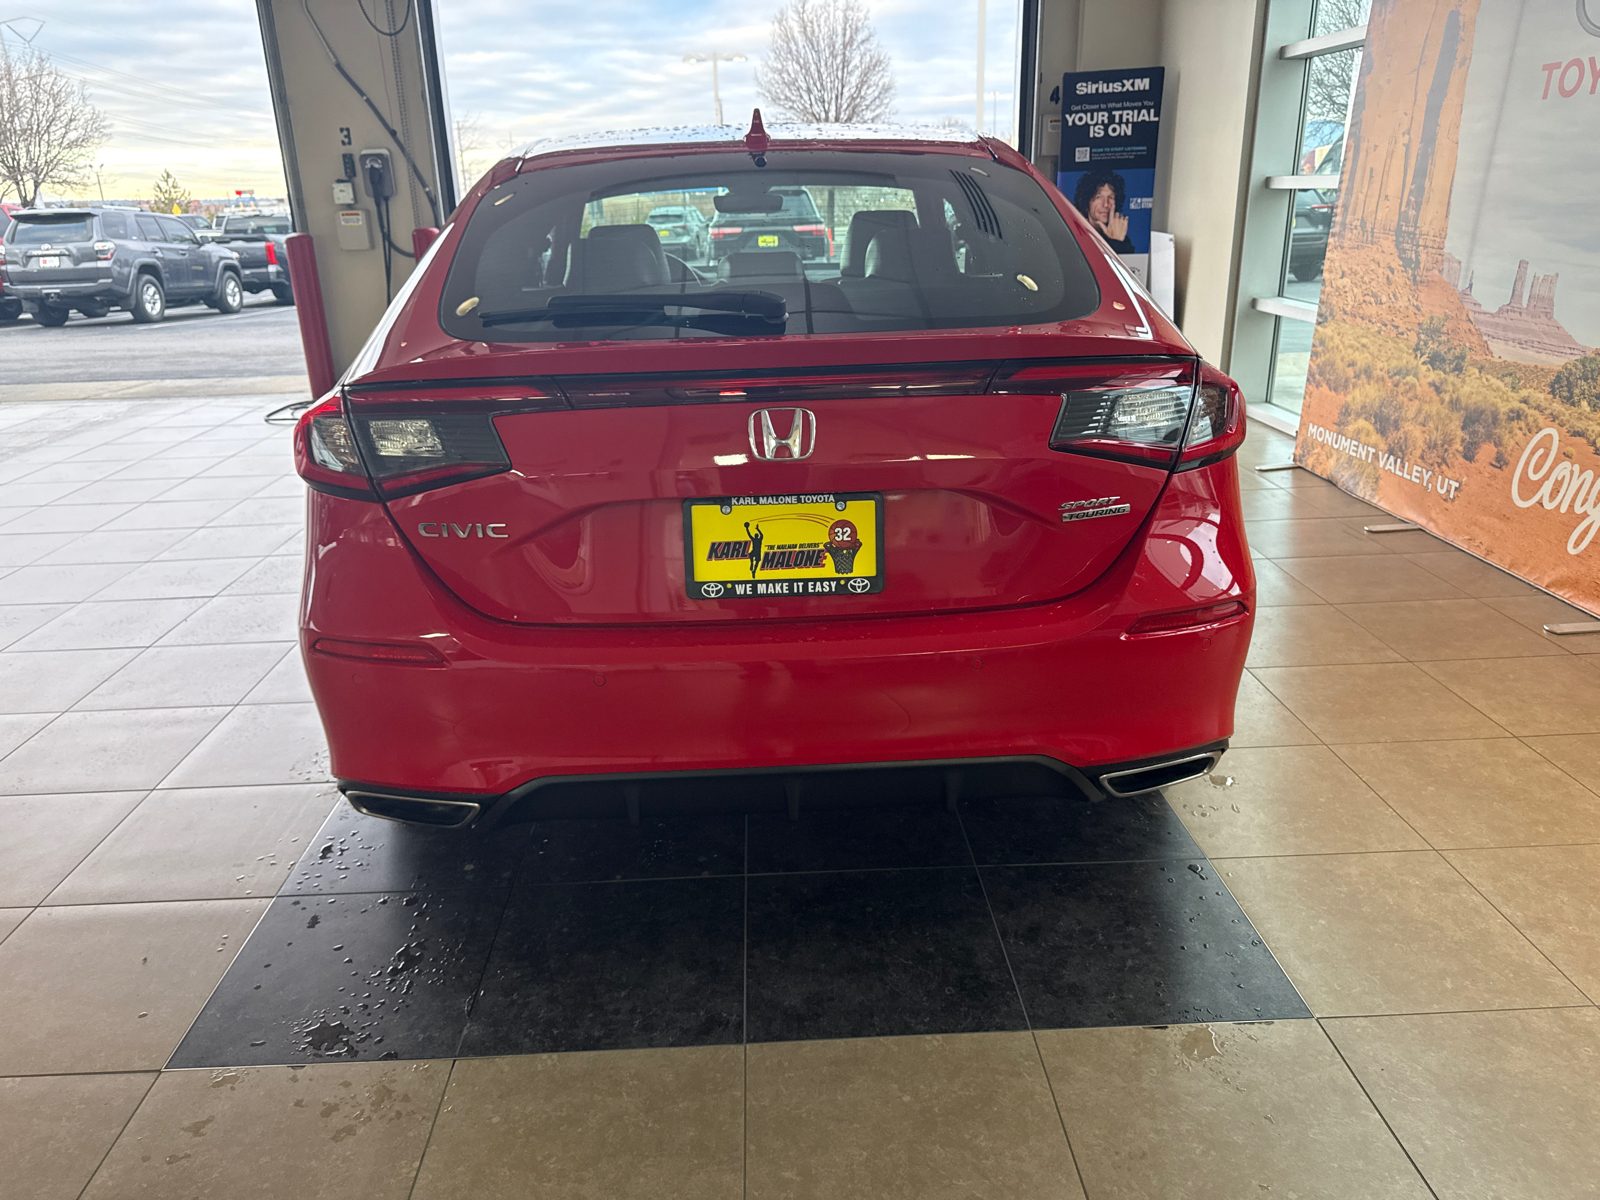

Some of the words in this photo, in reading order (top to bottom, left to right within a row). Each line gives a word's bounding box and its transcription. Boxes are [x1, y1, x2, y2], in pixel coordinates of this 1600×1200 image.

[1075, 77, 1150, 95] SiriusXM
[1050, 85, 1060, 105] 4
[1065, 111, 1109, 126] YOUR
[1112, 109, 1159, 123] TRIAL
[339, 127, 352, 146] 3
[1089, 125, 1105, 138] IS
[1108, 123, 1132, 137] ON
[1307, 423, 1376, 463] MONUMENT
[1378, 450, 1433, 492] VALLEY,
[1436, 475, 1460, 499] UT
[731, 496, 758, 506] KARL
[759, 495, 798, 505] MALONE
[799, 494, 835, 504] TOYOTA
[1058, 496, 1121, 510] SPORT
[1068, 506, 1126, 520] TOURING
[418, 522, 509, 538] CIVIC
[834, 527, 851, 541] 32
[707, 540, 751, 561] KARL
[760, 549, 828, 571] MALONE
[735, 583, 753, 595] WE
[757, 582, 789, 594] MAKE
[794, 581, 805, 593] IT
[808, 580, 837, 592] EASY
